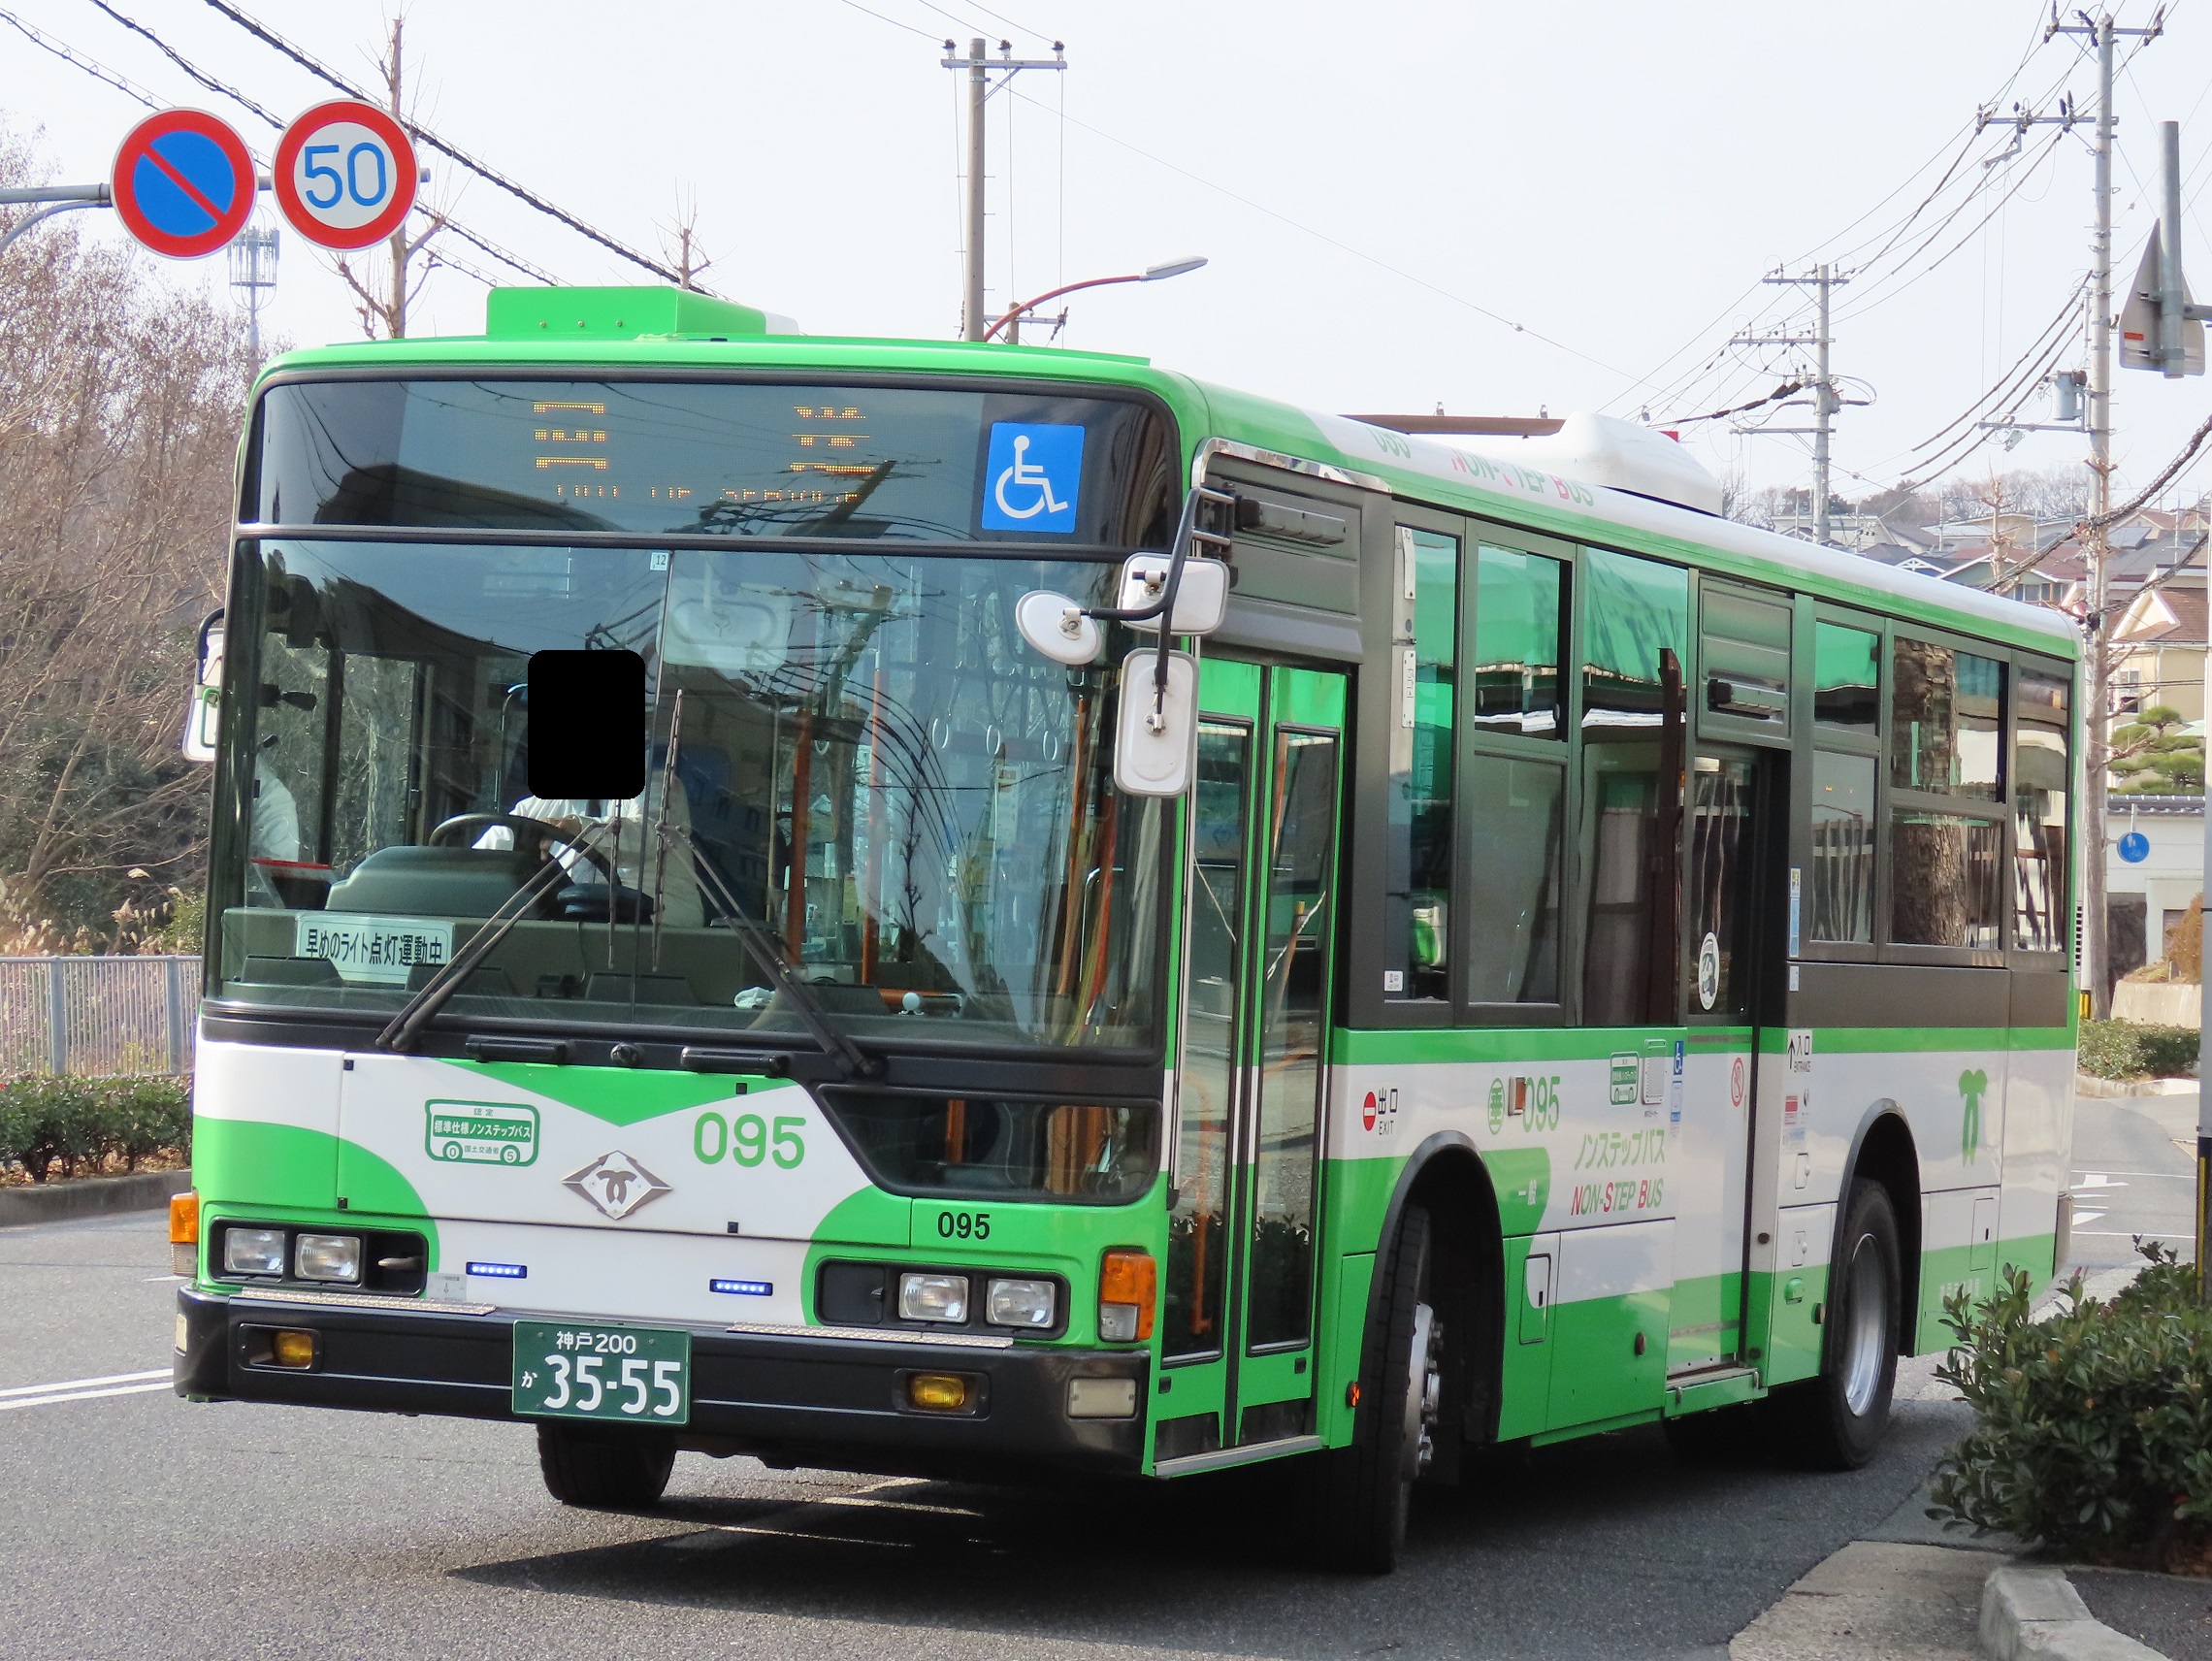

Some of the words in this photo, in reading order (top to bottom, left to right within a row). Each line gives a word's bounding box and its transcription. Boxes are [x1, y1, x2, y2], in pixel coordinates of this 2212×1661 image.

[305, 142, 387, 209] 50
[656, 554, 667, 566] 12
[305, 928, 443, 967] 早めのライト点灯運動中
[1796, 1034, 1810, 1057] 入口
[1378, 1087, 1398, 1115] 出口
[1522, 1076, 1561, 1133] 095
[434, 1120, 532, 1139] 標準仕様ノンステップバス
[694, 1112, 807, 1170] 095
[1379, 1120, 1394, 1135] EXIT
[449, 1147, 457, 1157] 0
[464, 1145, 500, 1155] 国土交通省
[506, 1151, 514, 1161] 5
[1574, 1129, 1665, 1171] ノンステップバス
[1570, 1181, 1637, 1217] NON-STEP
[1637, 1177, 1664, 1209] BUS
[937, 1211, 991, 1240] 095
[521, 1370, 538, 1389] か
[543, 1354, 681, 1417] 35-55
